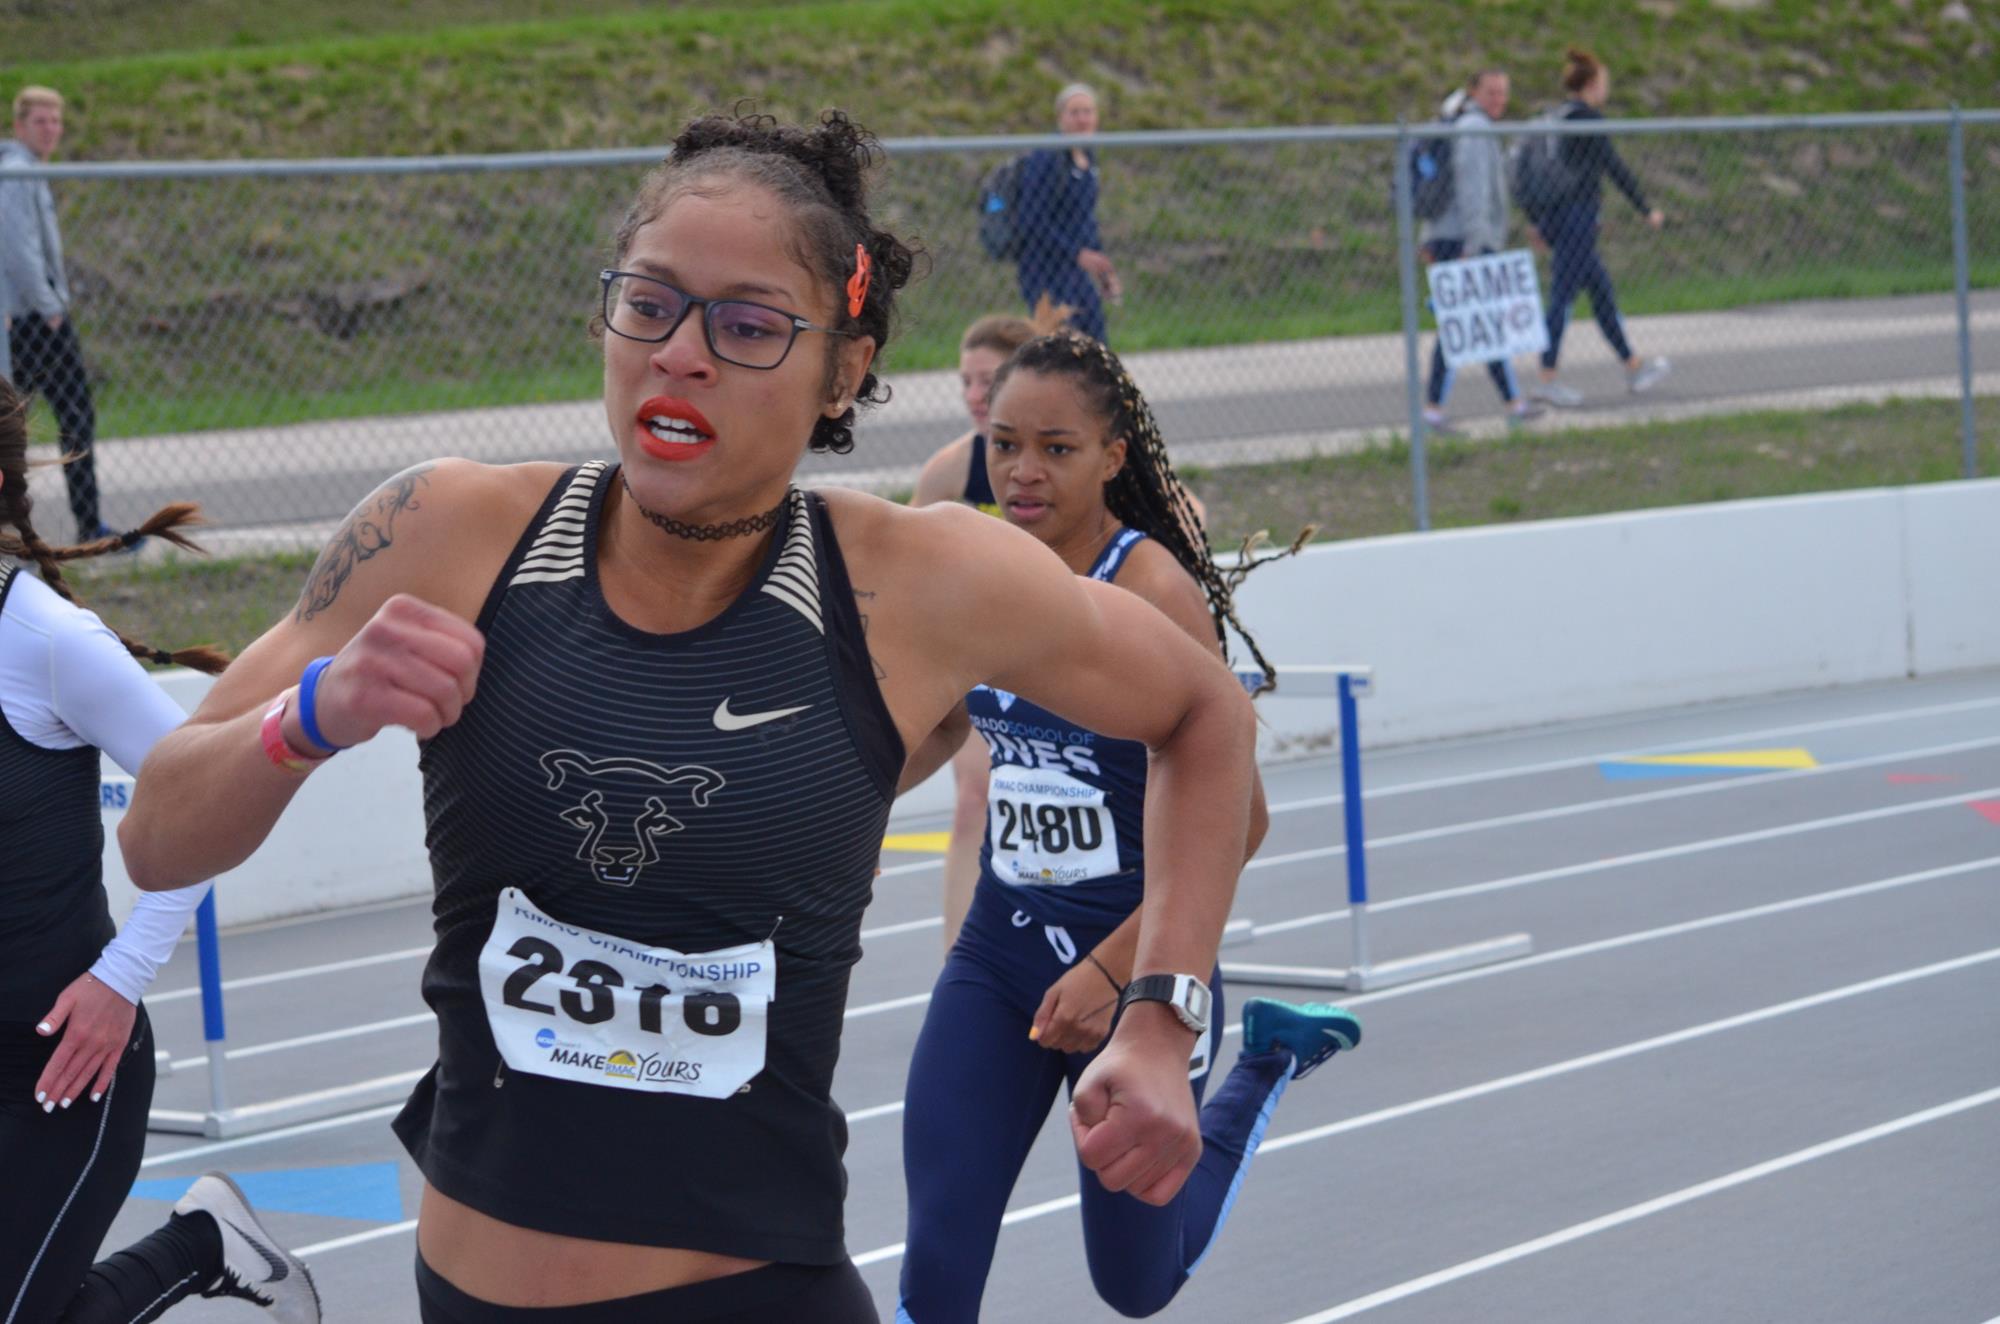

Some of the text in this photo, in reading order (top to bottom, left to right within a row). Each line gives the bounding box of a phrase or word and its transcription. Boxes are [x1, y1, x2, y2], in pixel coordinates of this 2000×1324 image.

[1435, 257, 1533, 312] GAME
[1443, 307, 1508, 355] DAY
[1067, 731, 1095, 746] OF
[1016, 782, 1097, 799] CHAMPIONSHIP
[997, 800, 1102, 854] 2480
[549, 1048, 703, 1082] MAKE RMAC YOURS
